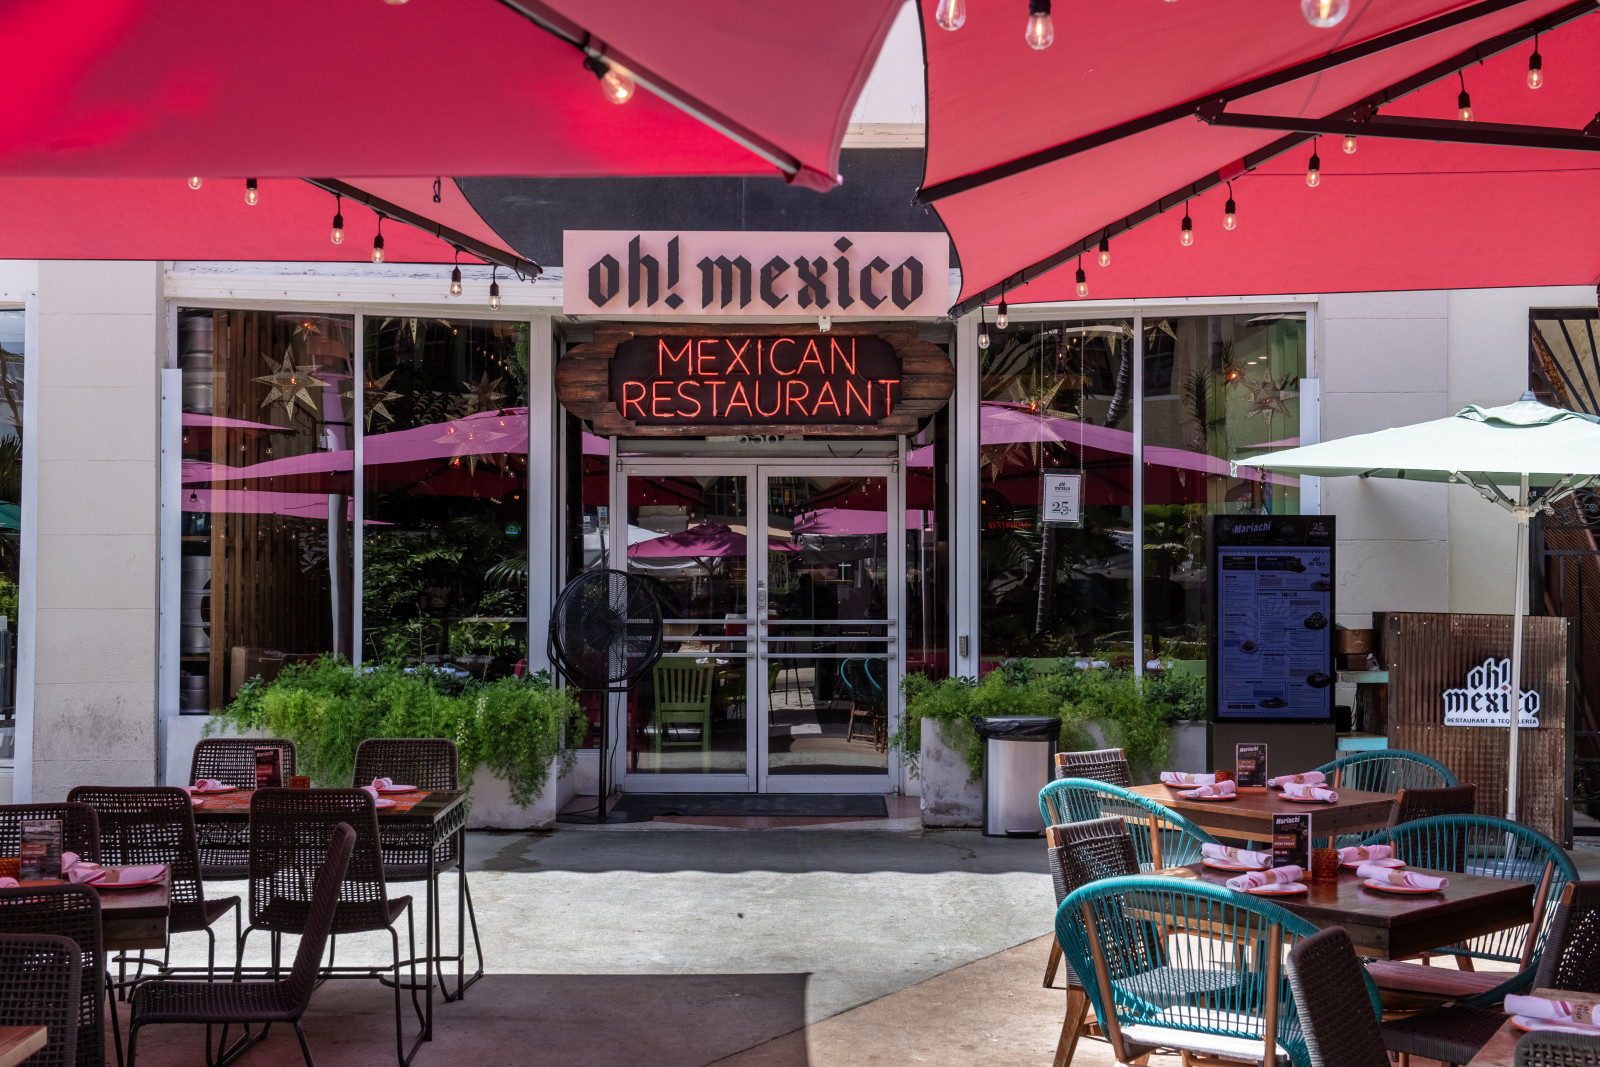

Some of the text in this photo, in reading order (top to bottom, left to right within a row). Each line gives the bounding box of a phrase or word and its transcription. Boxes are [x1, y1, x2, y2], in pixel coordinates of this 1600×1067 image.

[588, 234, 924, 311] oh! mexico
[658, 338, 856, 376] MEXICAN
[622, 379, 900, 418] RESTAURANT
[1051, 501, 1069, 516] 25
[1234, 520, 1272, 534] Mariachi
[1470, 660, 1509, 691] oh!
[1275, 816, 1300, 825] Mariachi
